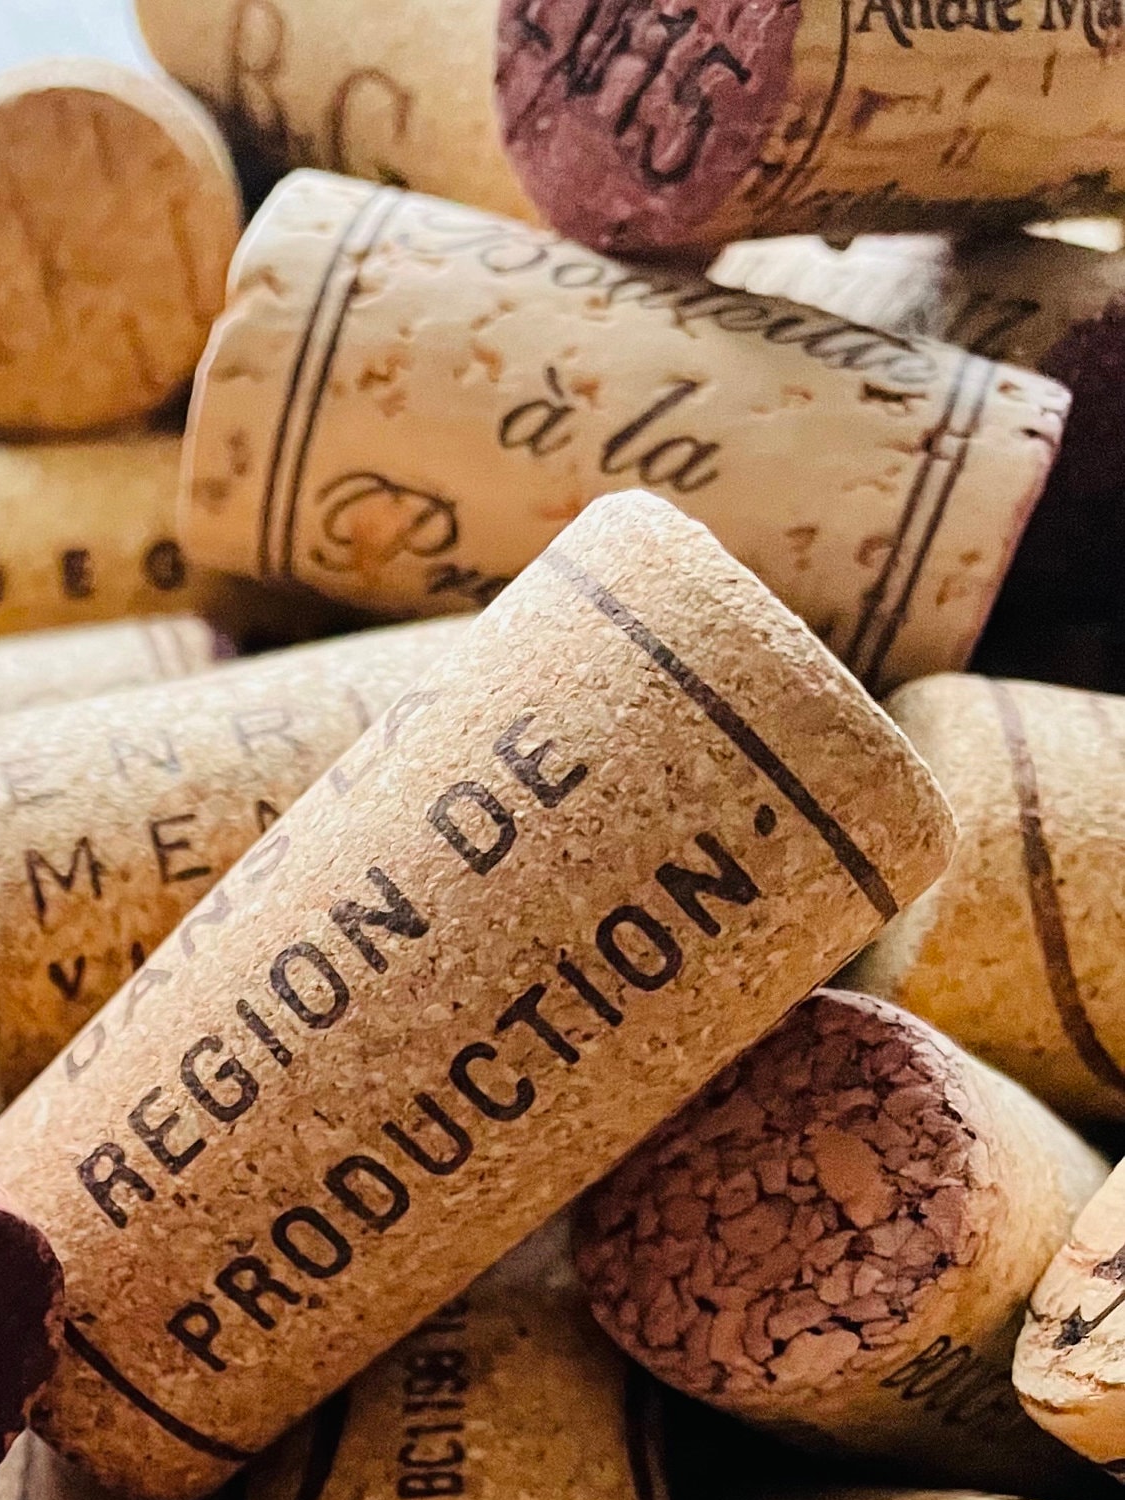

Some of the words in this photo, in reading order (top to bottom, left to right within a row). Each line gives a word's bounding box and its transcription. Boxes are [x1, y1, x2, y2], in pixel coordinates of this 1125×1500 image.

[600, 376, 721, 492] la
[79, 865, 430, 1228] REGION
[426, 712, 589, 876] DE
